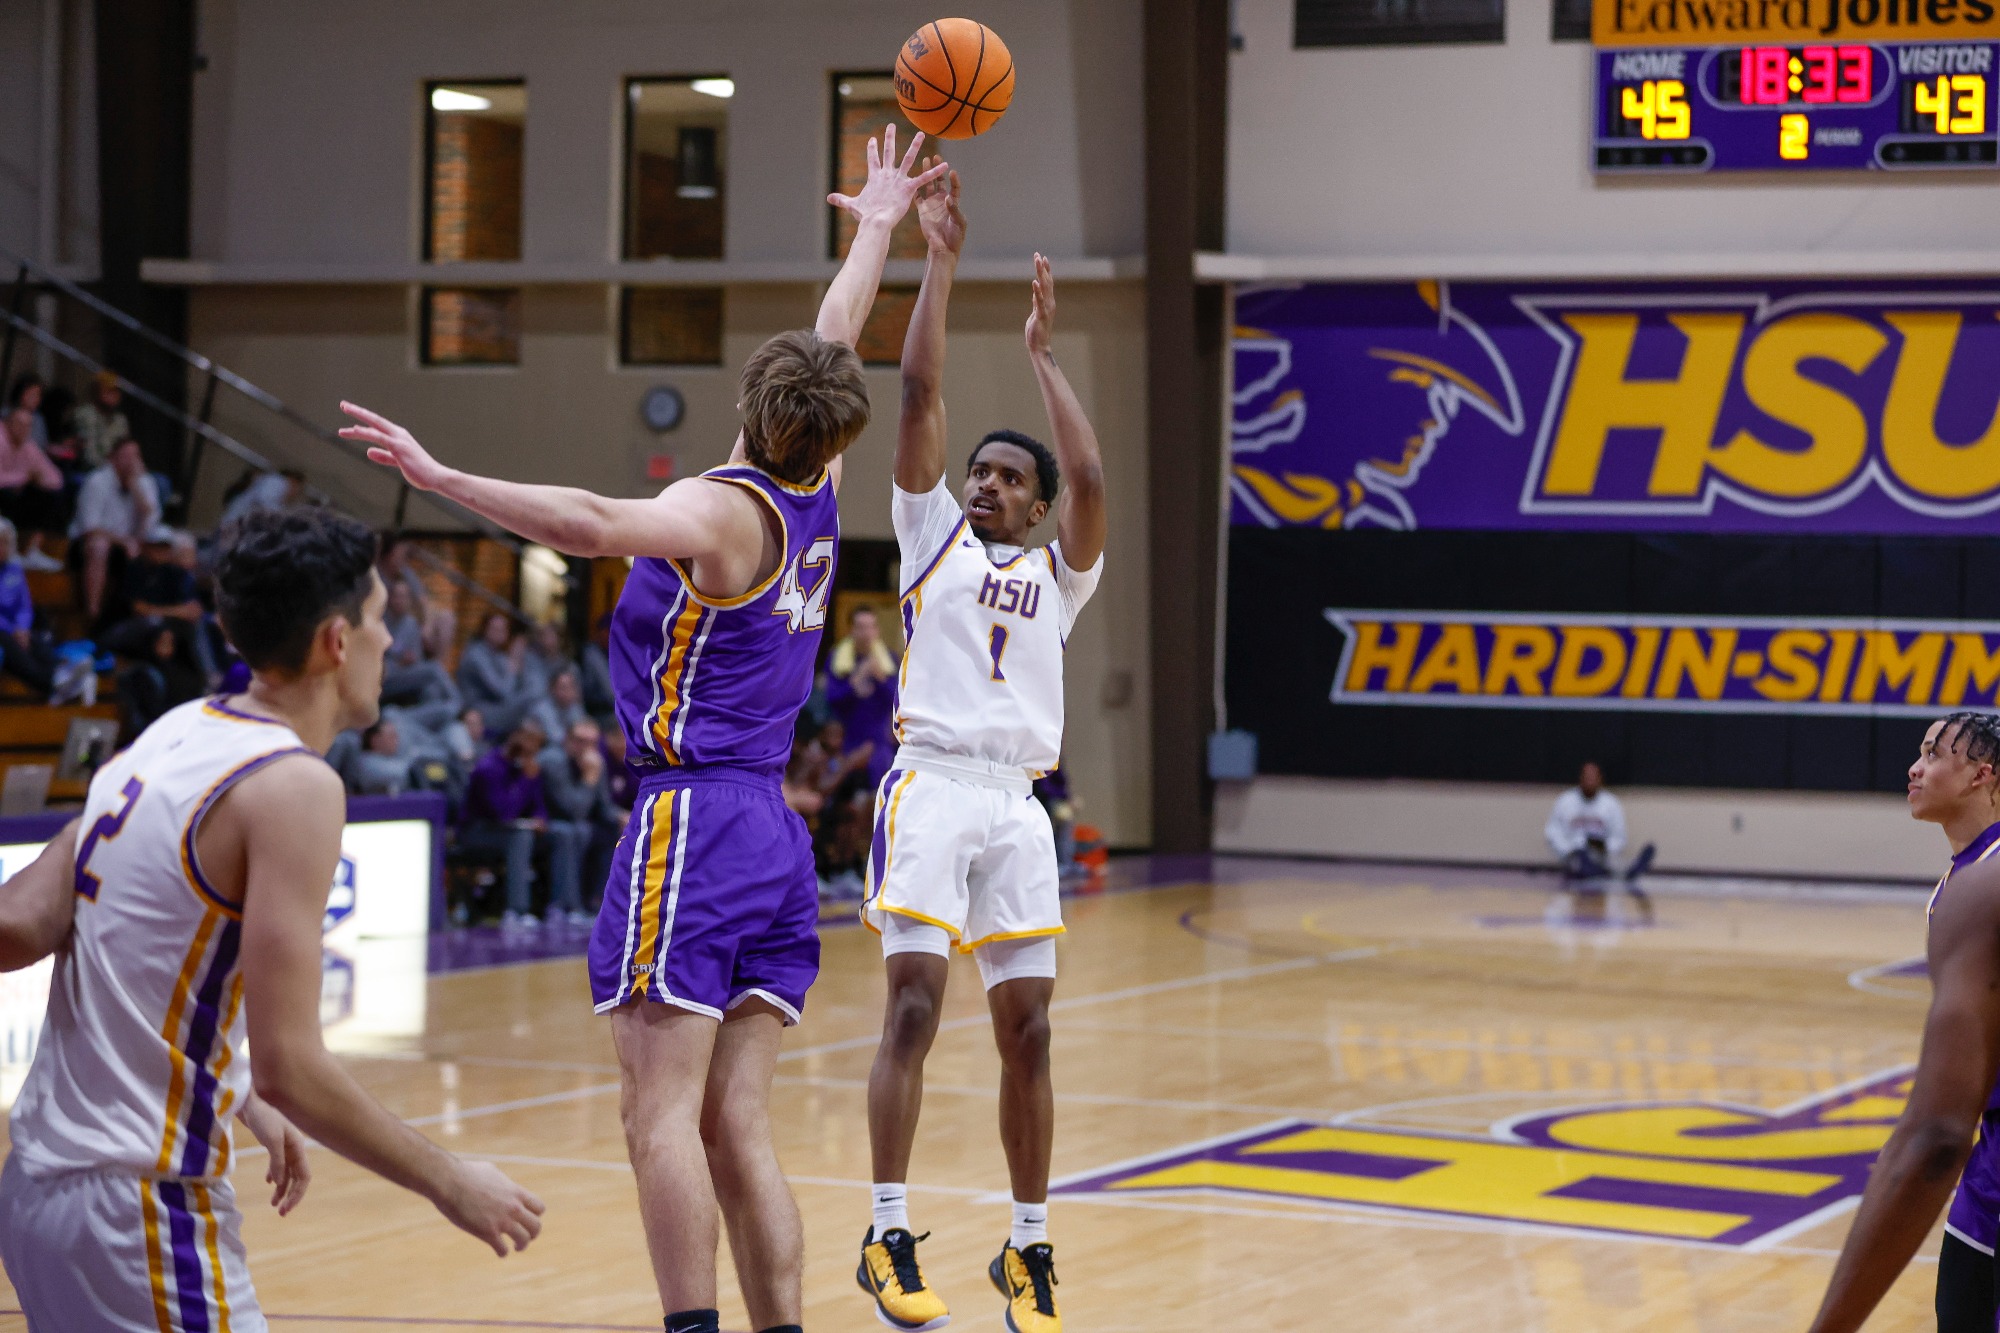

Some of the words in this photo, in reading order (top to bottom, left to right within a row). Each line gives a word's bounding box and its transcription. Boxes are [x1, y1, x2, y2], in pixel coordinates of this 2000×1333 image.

[1612, 0, 1809, 33] Edward
[1819, 0, 1994, 35] Jones
[1612, 53, 1686, 79] HOME
[1740, 46, 1872, 104] 18:33
[1898, 46, 1991, 74] VISITOR
[1622, 80, 1691, 139] 45
[1915, 74, 1985, 134] 43
[1779, 113, 1809, 160] 2
[1542, 311, 2000, 498] HSU
[771, 536, 834, 635] 42
[977, 571, 1041, 620] HSU
[988, 622, 1010, 683] 1
[1344, 621, 2000, 707] HARDIN-SIMM
[74, 774, 145, 905] 2
